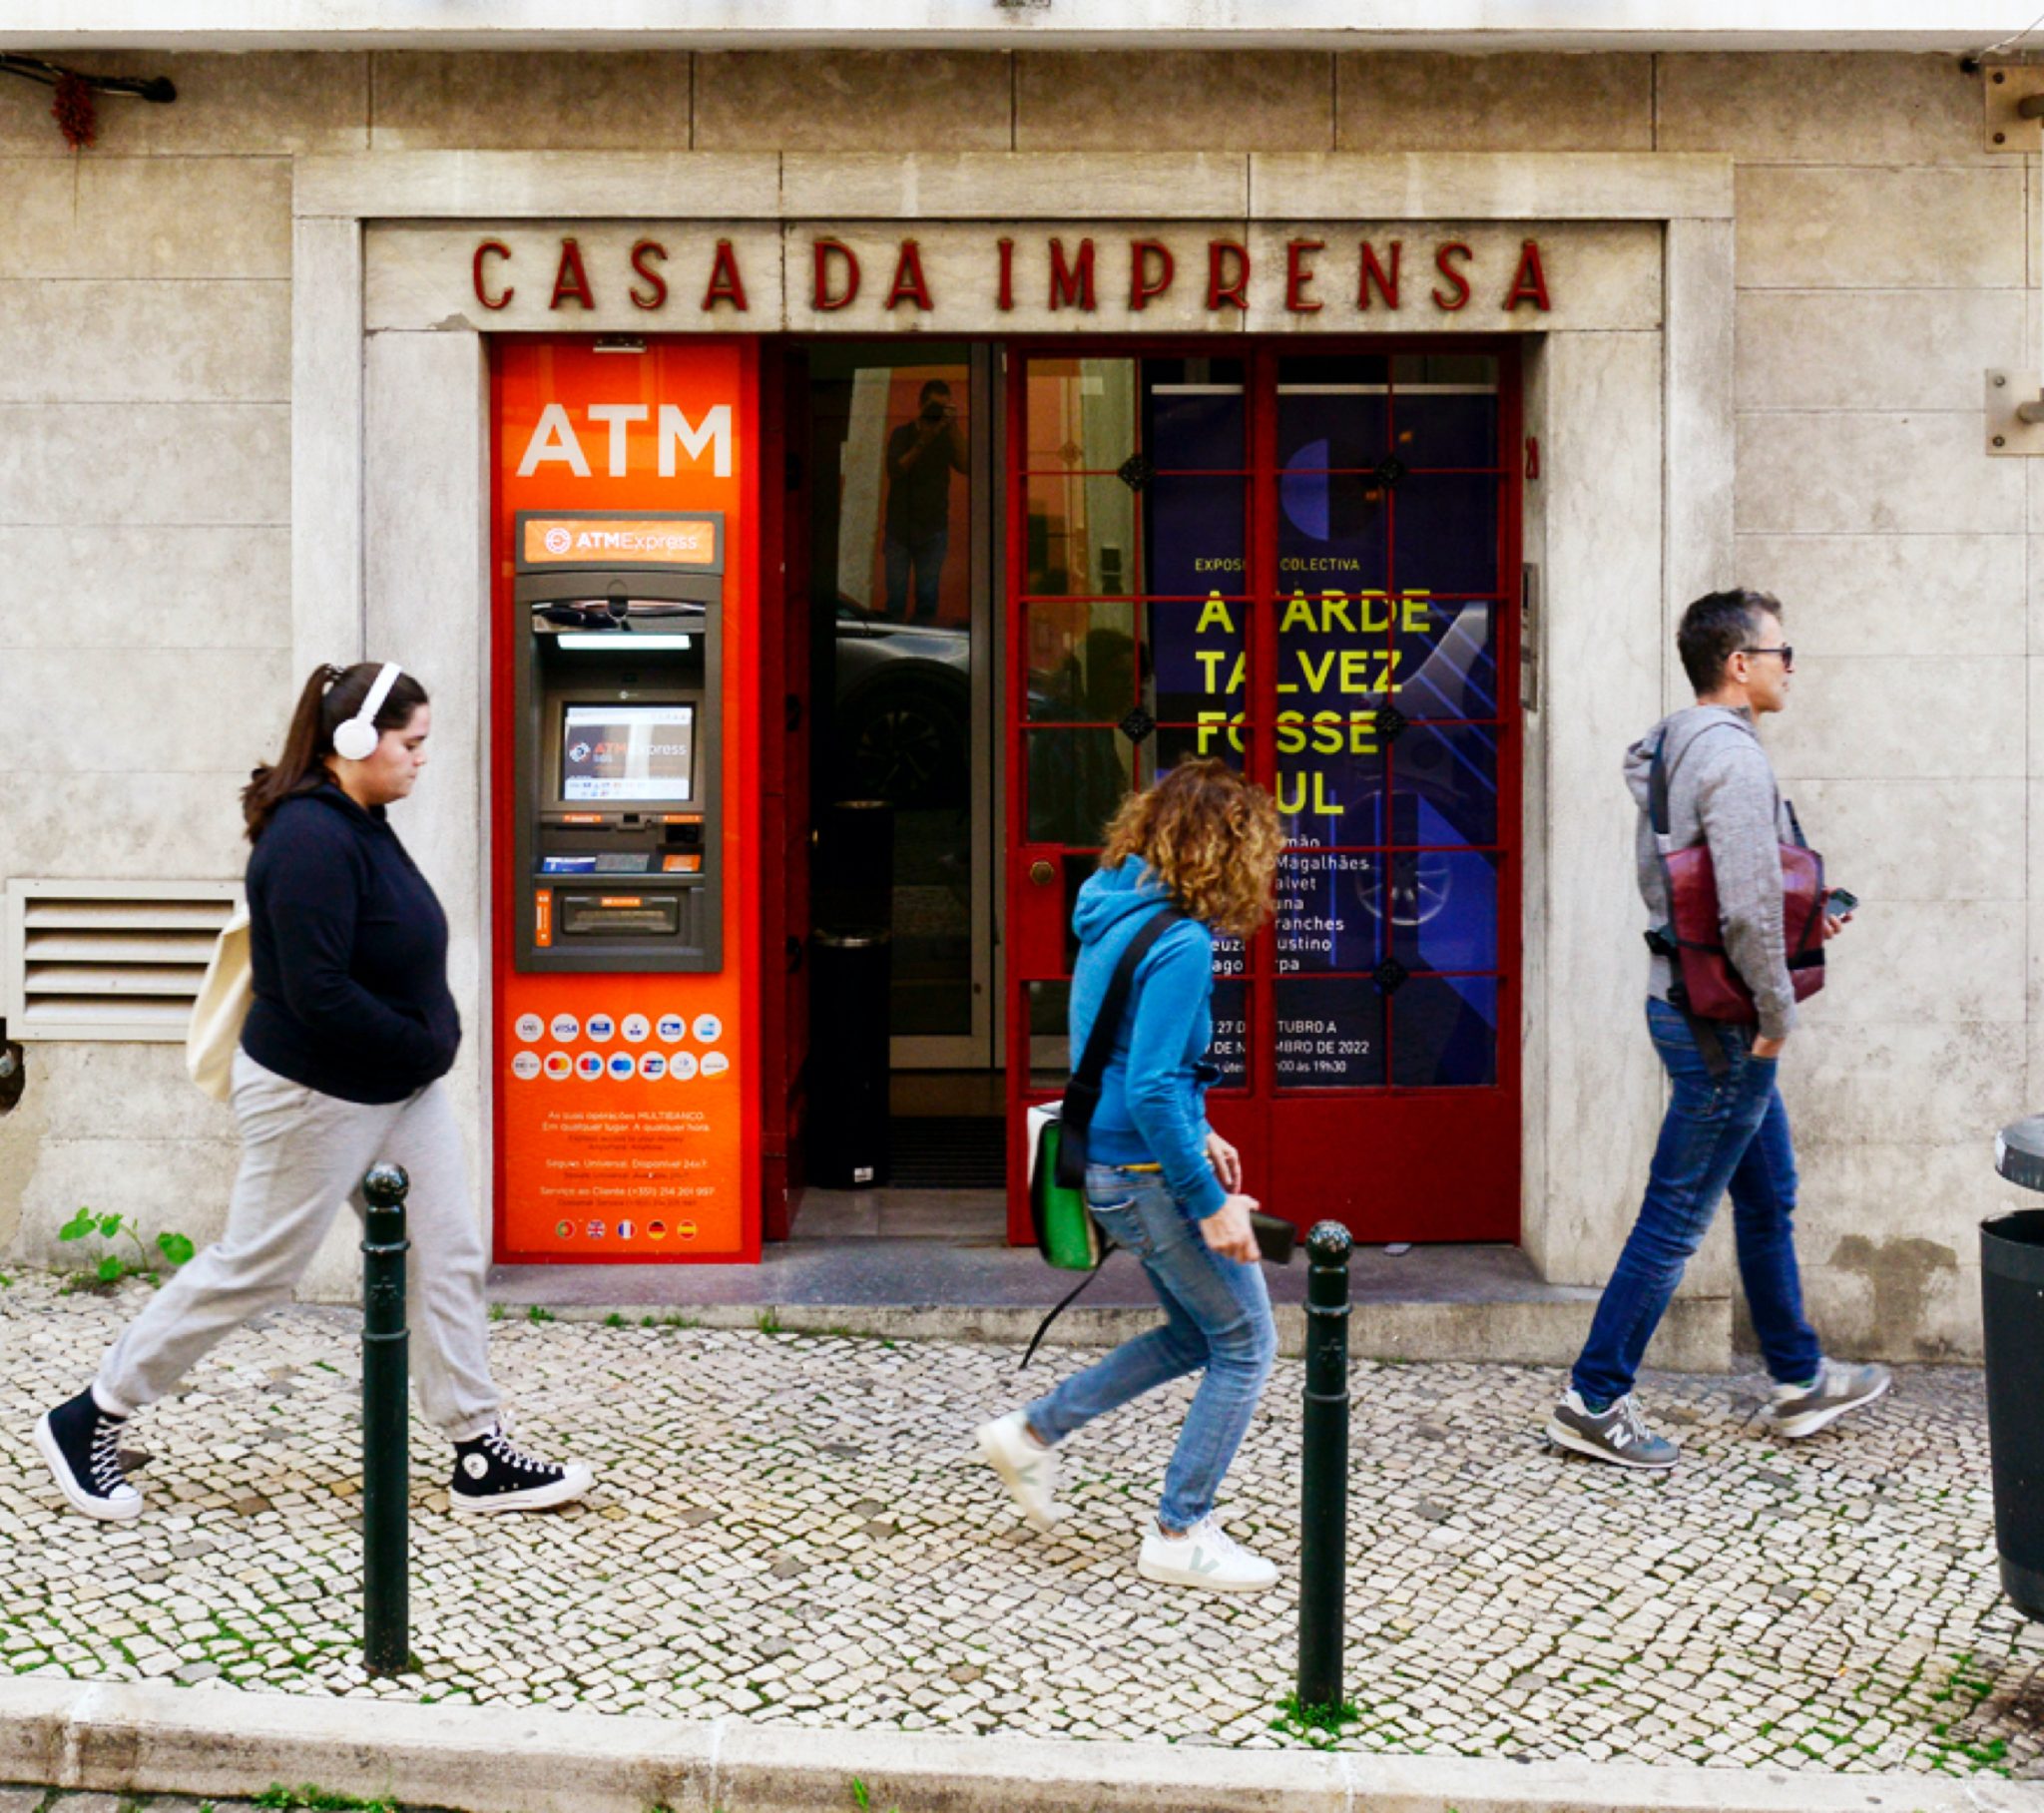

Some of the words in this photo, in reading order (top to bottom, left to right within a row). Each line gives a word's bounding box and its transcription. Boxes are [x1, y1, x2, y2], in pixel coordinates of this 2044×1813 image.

[472, 237, 751, 312] CASA
[812, 238, 935, 312] DA
[997, 238, 1554, 314] IMPRENSA
[515, 403, 733, 478] ATM
[576, 531, 698, 552] ATMExpress
[1279, 558, 1360, 572] COLECTIVA
[1196, 590, 1236, 633] A
[1276, 589, 1431, 633] ARDE
[1276, 770, 1344, 815] UL
[1217, 1021, 1233, 1034] 27
[1325, 1021, 1337, 1034] A
[1214, 1041, 1234, 1055] DE
[1316, 1041, 1335, 1055] DE
[1337, 1041, 1371, 1055] 2022
